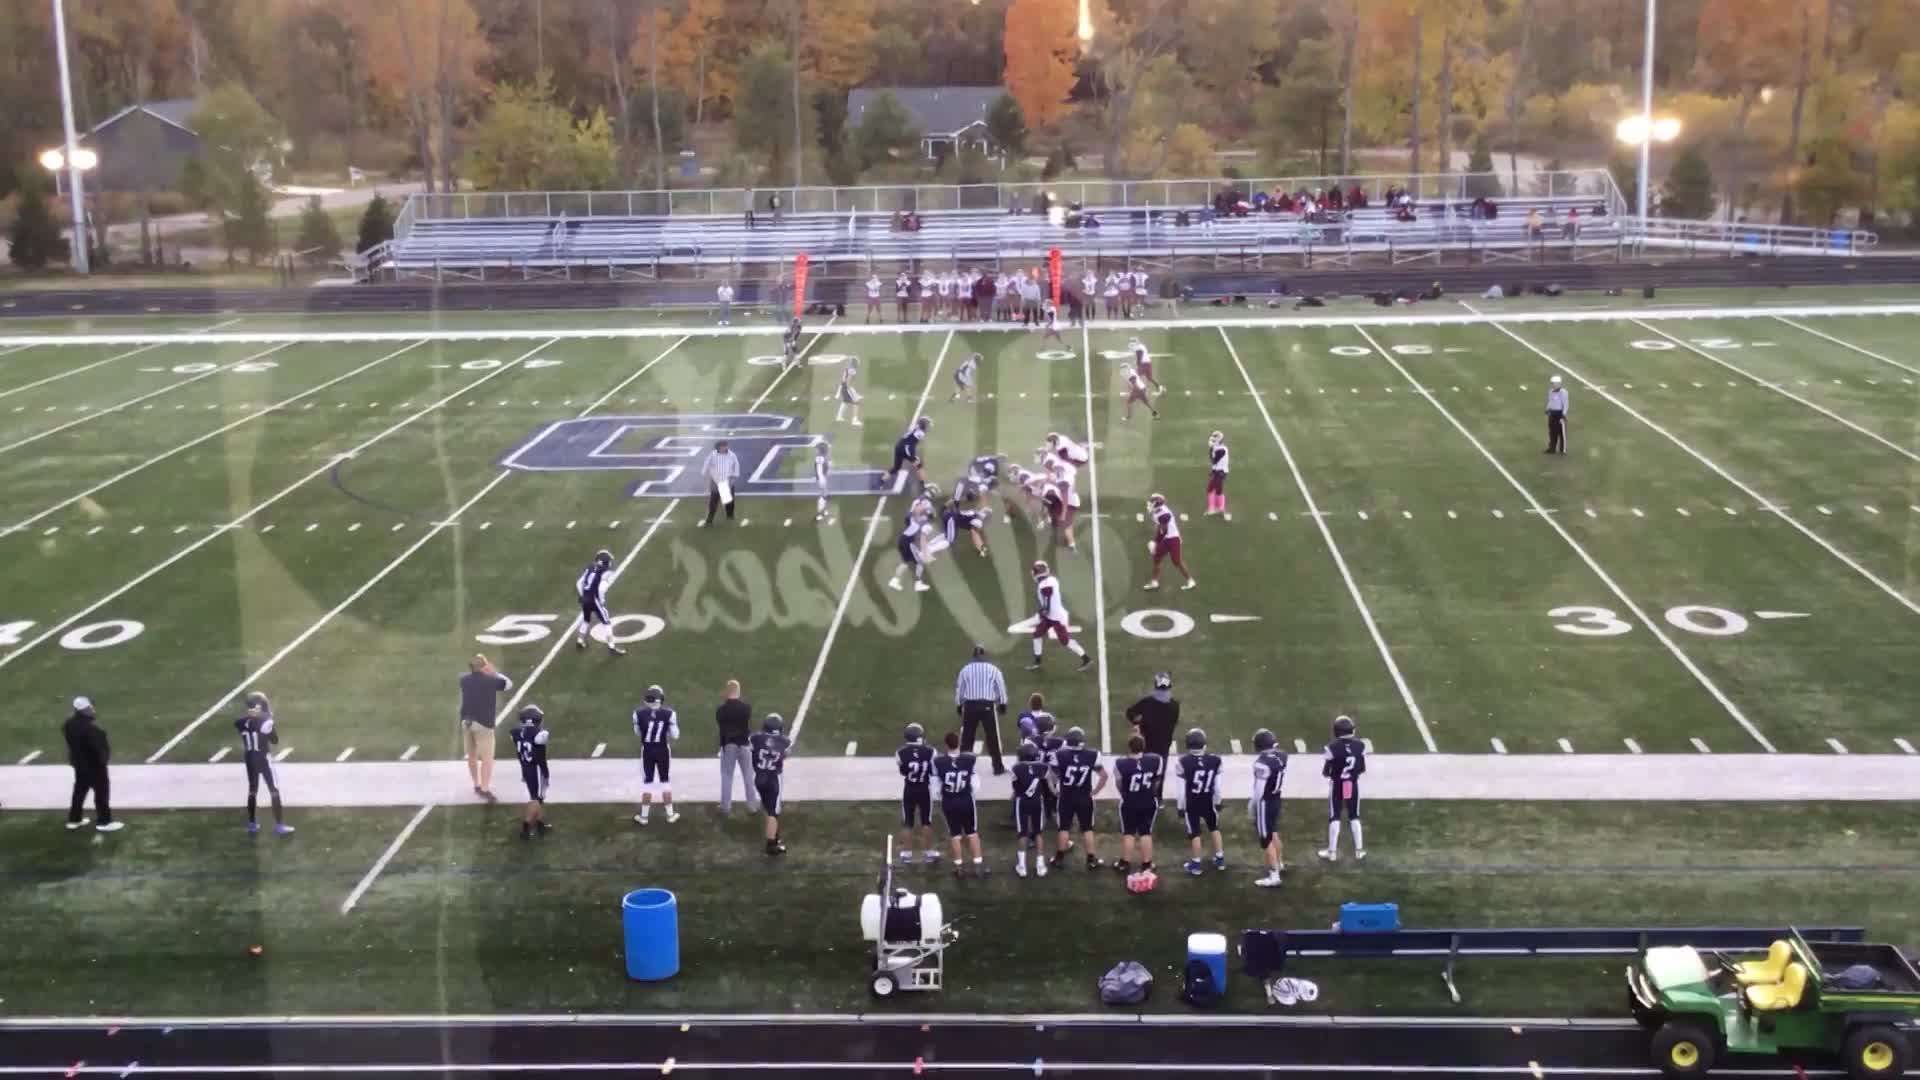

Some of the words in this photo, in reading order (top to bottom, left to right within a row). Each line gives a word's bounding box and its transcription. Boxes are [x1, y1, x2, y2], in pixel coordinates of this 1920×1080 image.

[475, 614, 666, 645] 50
[1547, 605, 1749, 636] 30
[644, 720, 664, 743] 11
[907, 762, 929, 784] 21
[1062, 765, 1091, 787] 57
[1340, 755, 1356, 779] 2
[1191, 769, 1215, 794] 51
